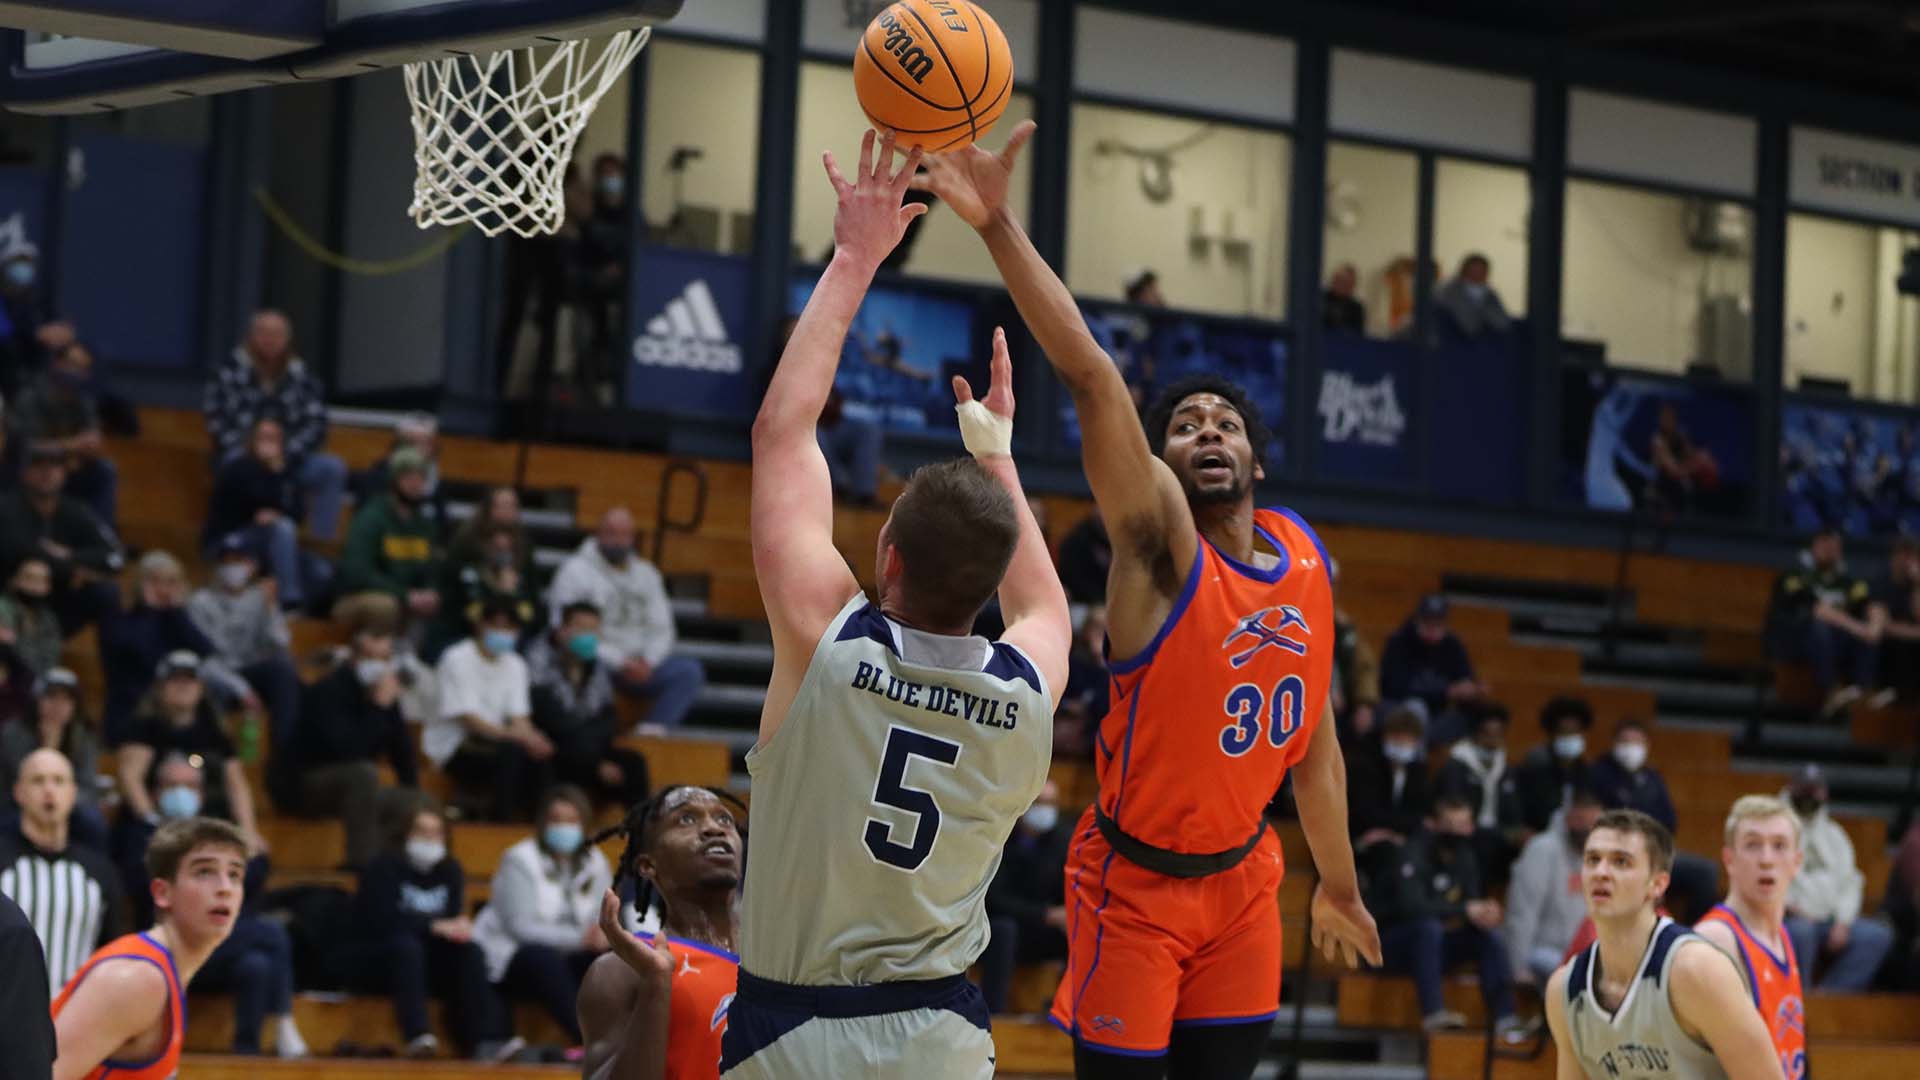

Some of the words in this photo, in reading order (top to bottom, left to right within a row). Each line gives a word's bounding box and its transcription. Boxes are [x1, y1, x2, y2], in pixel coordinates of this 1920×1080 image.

[880, 8, 934, 86] Wilso
[632, 335, 742, 373] adidas
[851, 660, 923, 708] BLUE
[925, 685, 1019, 730] DEVILS
[1219, 674, 1305, 757] 30
[861, 723, 963, 873] 5
